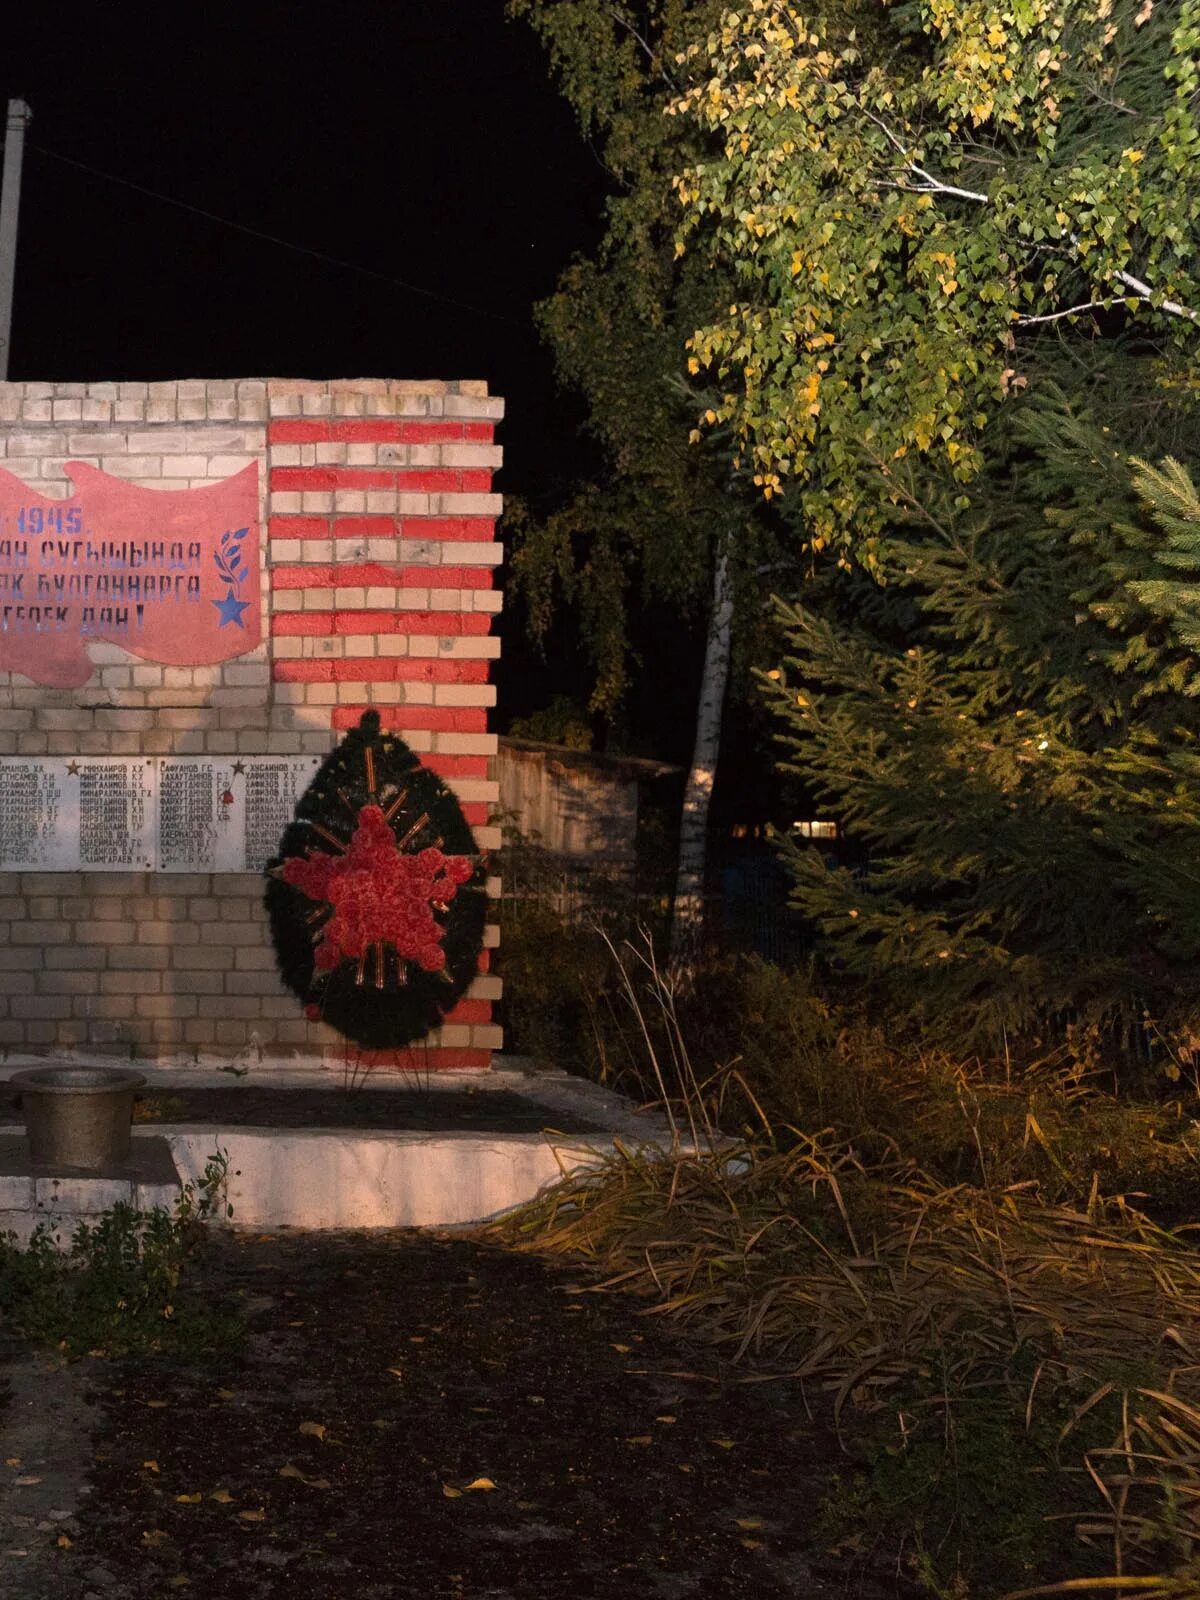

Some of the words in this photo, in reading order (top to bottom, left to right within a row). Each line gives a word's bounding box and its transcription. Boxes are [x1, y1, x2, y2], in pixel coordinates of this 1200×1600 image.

[40, 540, 200, 569] СУГЫШЫНДА
[37, 573, 200, 601] БУЛГАННАРГА
[80, 604, 144, 636] ДАН!
[250, 763, 289, 772] ХУСАИНОВ
